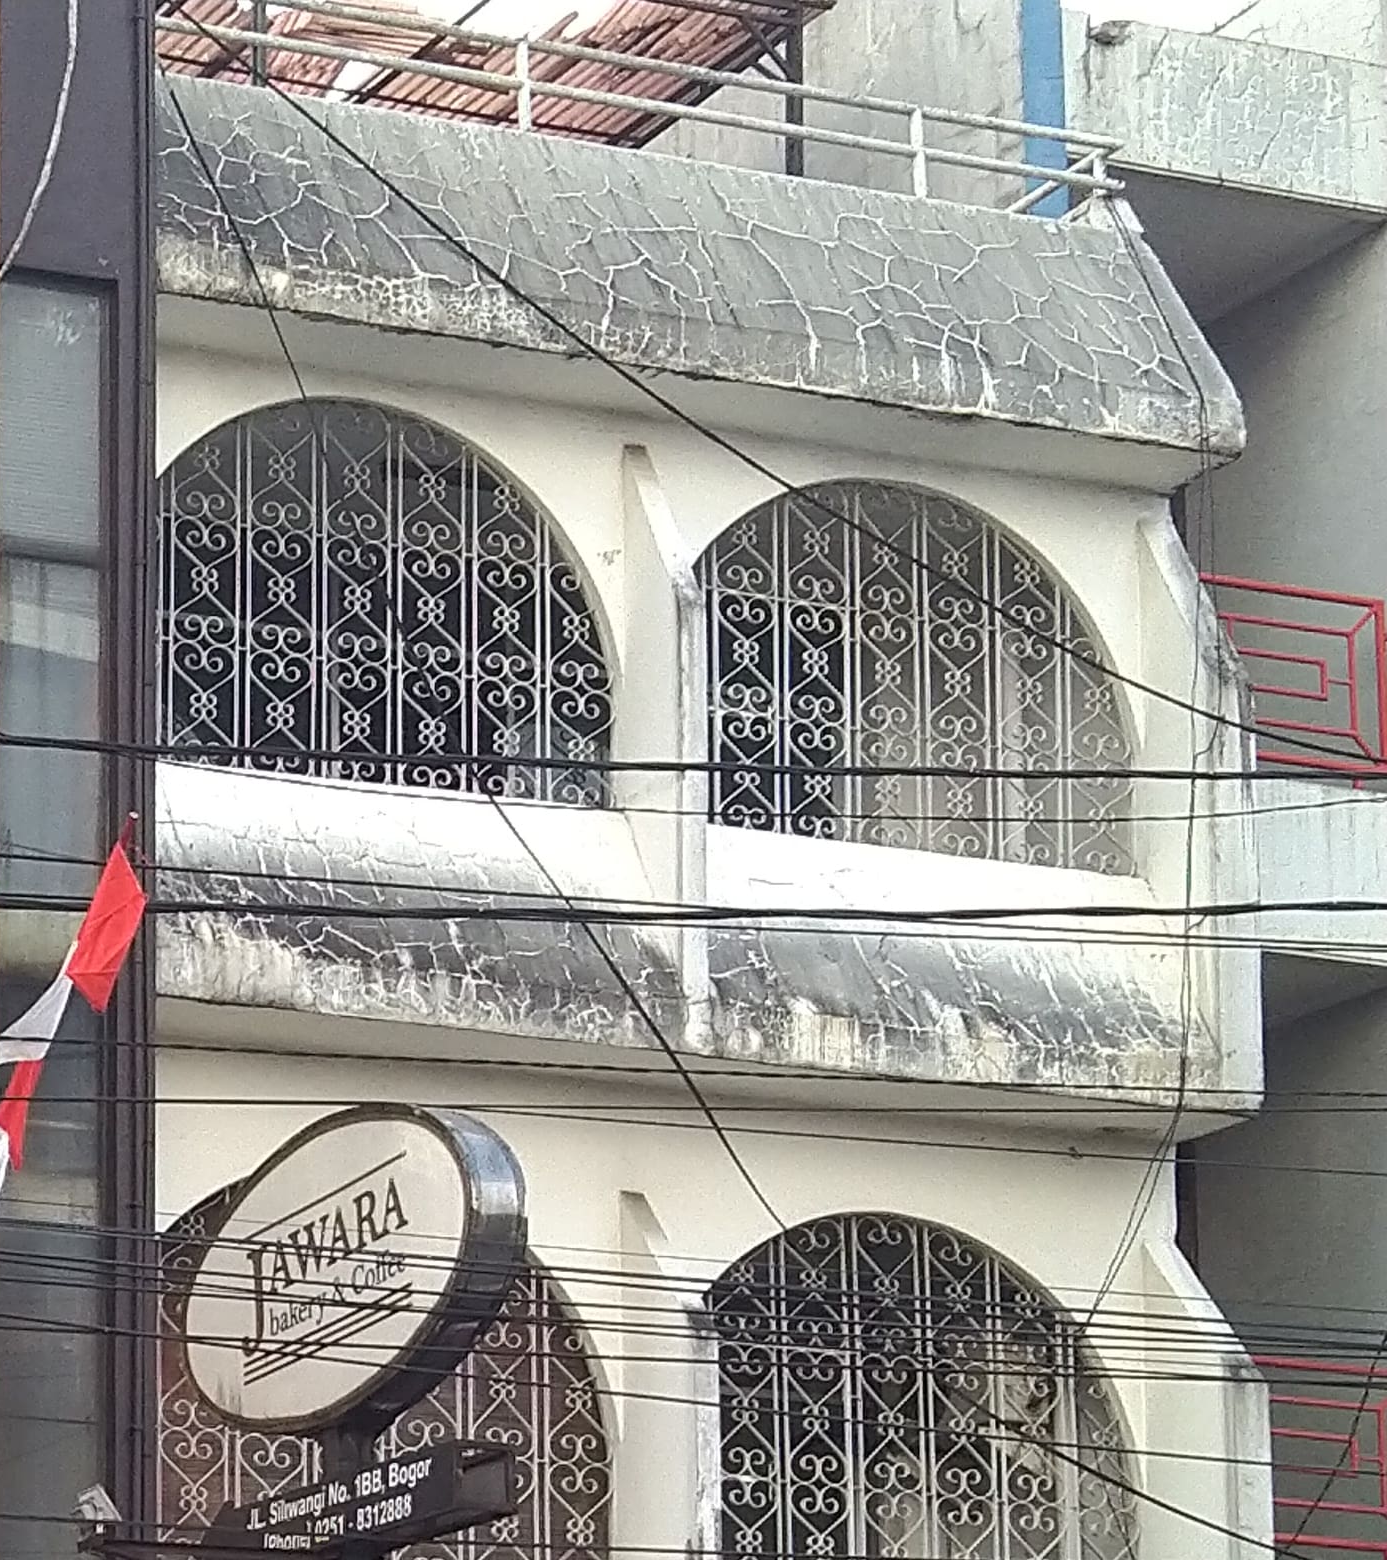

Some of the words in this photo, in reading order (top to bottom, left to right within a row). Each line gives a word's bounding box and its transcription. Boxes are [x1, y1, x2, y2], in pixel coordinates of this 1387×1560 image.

[242, 1177, 409, 1357] JAWARA
[268, 1291, 327, 1337] bakery
[332, 1276, 346, 1304] &
[328, 1480, 352, 1507] No.
[387, 1457, 433, 1488] Bogor
